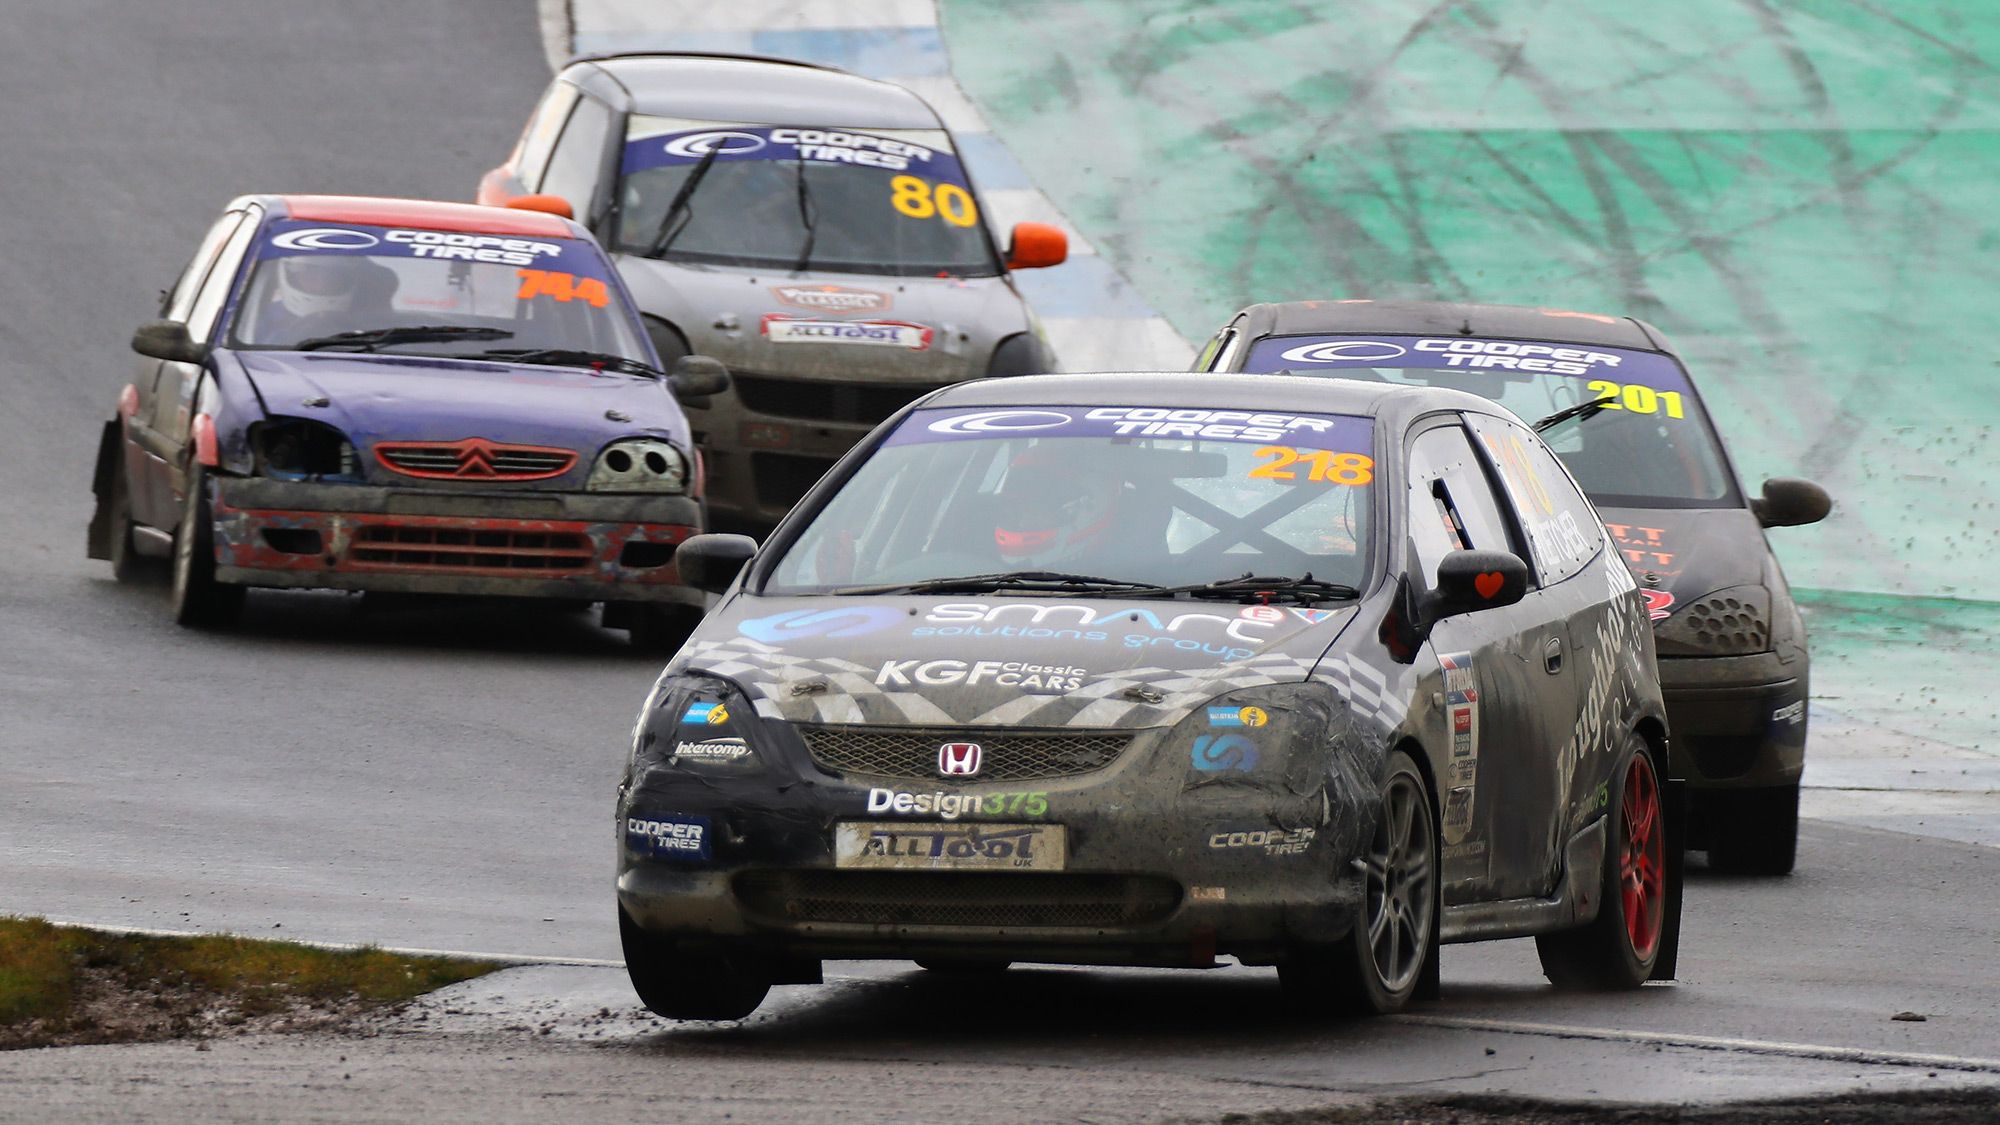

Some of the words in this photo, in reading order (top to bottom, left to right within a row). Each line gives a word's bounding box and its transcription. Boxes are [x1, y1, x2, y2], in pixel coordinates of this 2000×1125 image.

[769, 128, 933, 162] COOPER
[794, 144, 910, 170] TIRES
[890, 174, 978, 228] 80
[384, 230, 562, 258] COOPER
[408, 243, 535, 265] TIRES
[516, 268, 610, 308] 744
[1413, 338, 1622, 367] COOPER
[1441, 353, 1588, 375] TIRES
[1586, 380, 1684, 420] 201
[1084, 407, 1334, 433] COOPER
[1112, 420, 1288, 442] TIRES
[1247, 445, 1375, 486] 218
[911, 625, 1109, 641] solutions
[1123, 634, 1256, 662] group
[874, 659, 1004, 686] KGF
[1001, 662, 1087, 677] Classic
[995, 672, 1083, 690] CARS
[675, 740, 747, 759] Intercomp
[867, 788, 1048, 818] Design375
[628, 818, 704, 838] COOPER
[1209, 827, 1316, 848] COOPER
[658, 836, 701, 850] TIRES
[1013, 858, 1033, 867] UK
